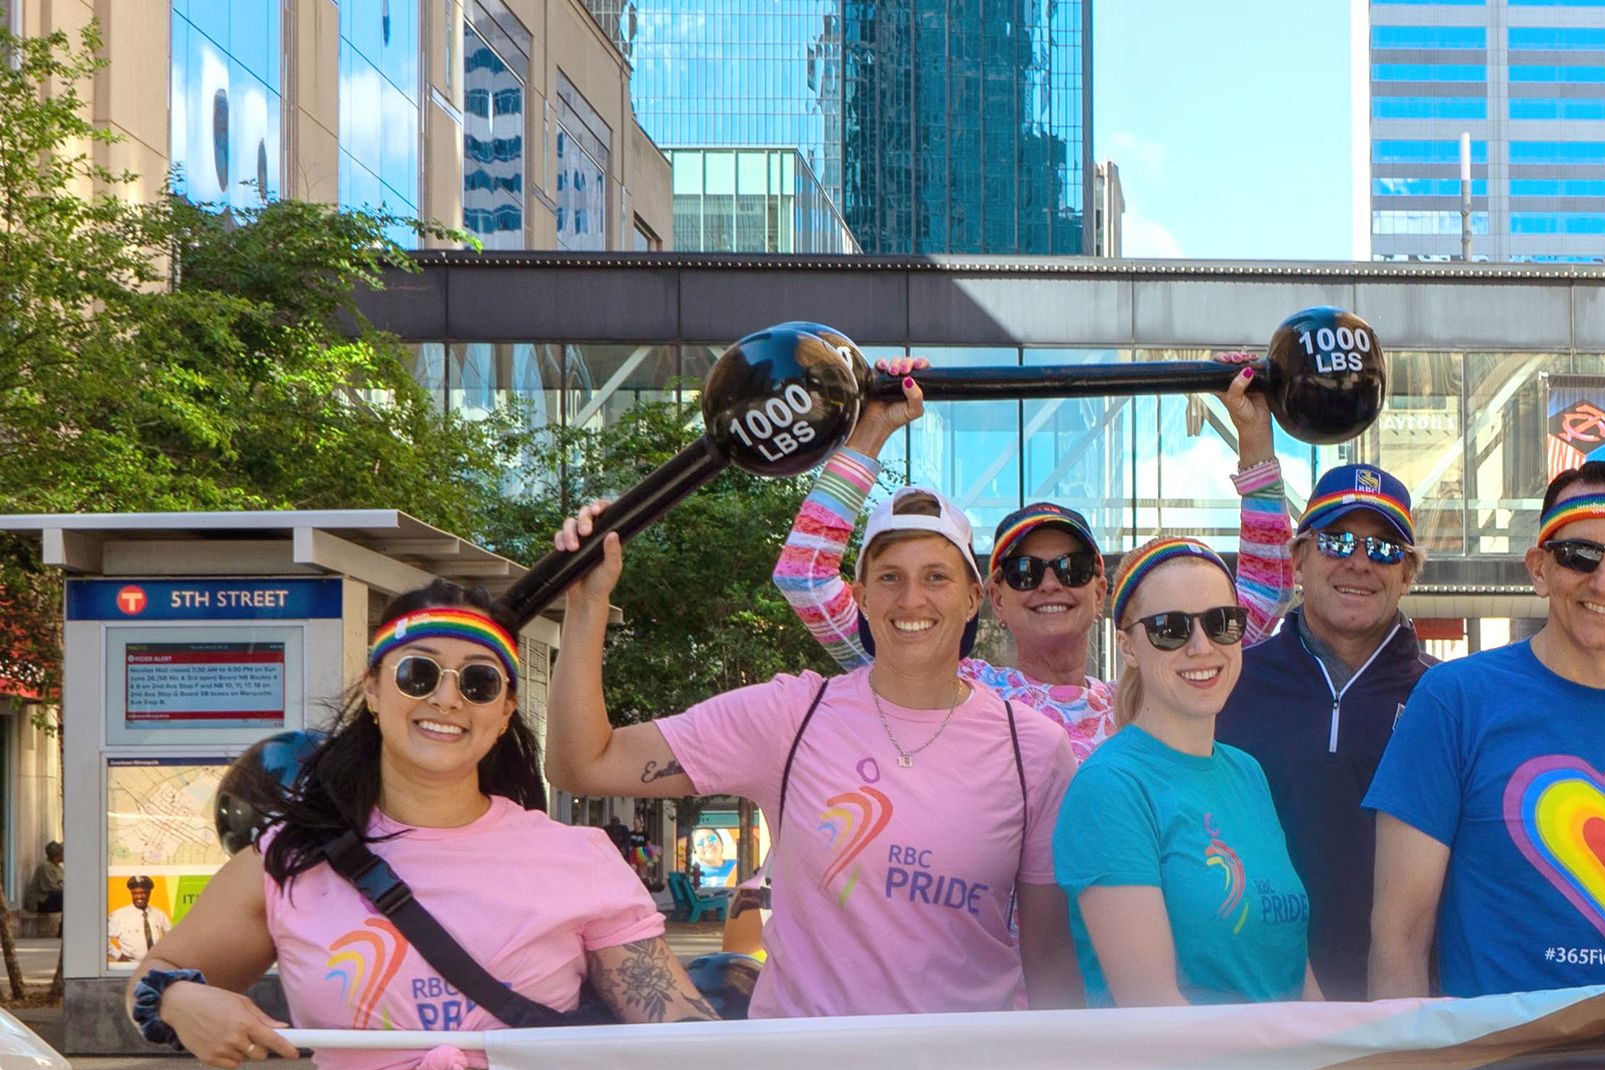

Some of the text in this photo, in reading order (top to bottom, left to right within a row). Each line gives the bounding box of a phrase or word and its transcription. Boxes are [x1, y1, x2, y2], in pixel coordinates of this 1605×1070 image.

[1299, 326, 1370, 355] 1000
[1315, 352, 1364, 373] LBS
[730, 384, 813, 447] 1000
[758, 420, 816, 463] LBS
[171, 590, 288, 608] 5TH STREET
[888, 844, 933, 869] RBC
[886, 867, 989, 915] PRIDE
